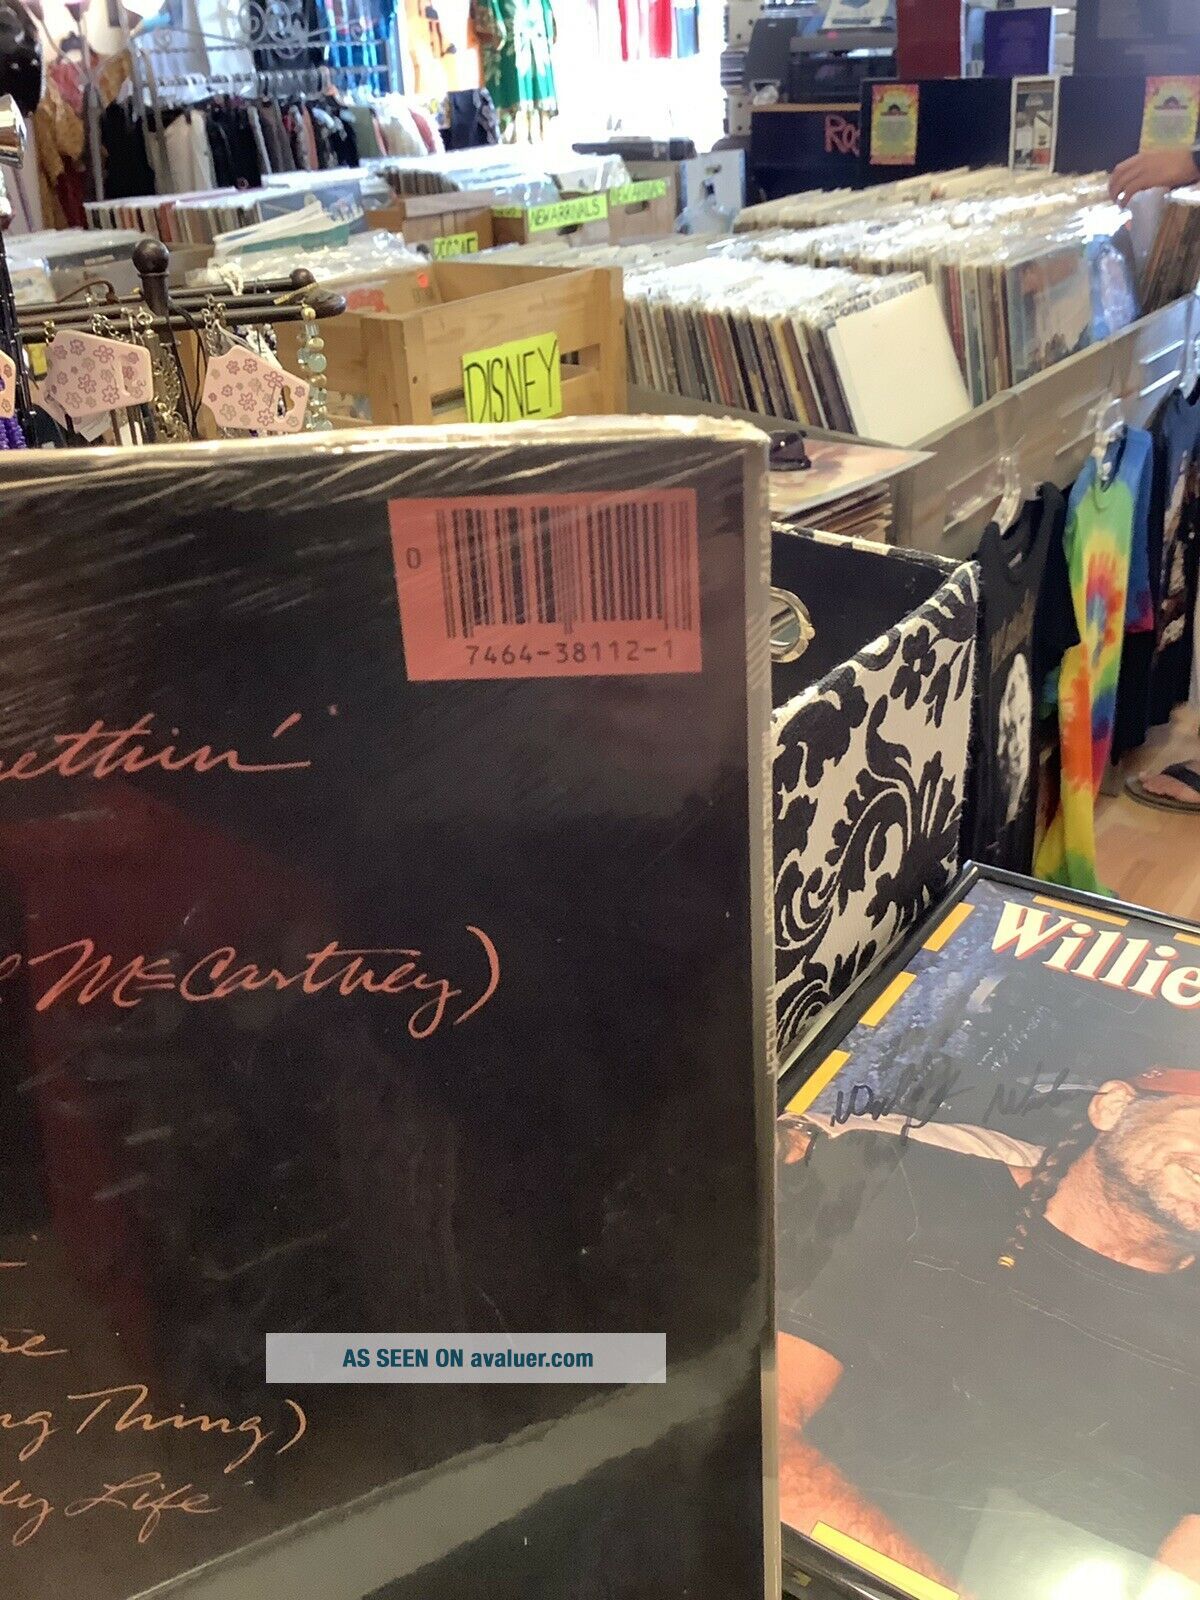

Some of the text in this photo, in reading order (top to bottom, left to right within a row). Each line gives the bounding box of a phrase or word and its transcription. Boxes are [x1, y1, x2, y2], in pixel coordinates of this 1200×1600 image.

[465, 339, 558, 423] DISNEY
[405, 546, 422, 570] 0
[465, 639, 674, 666] 7464-38112-1
[0, 712, 311, 780] ethin'
[991, 900, 1200, 1010] Willie
[67, 1384, 307, 1474] Thing)
[64, 1471, 222, 1543] Life
